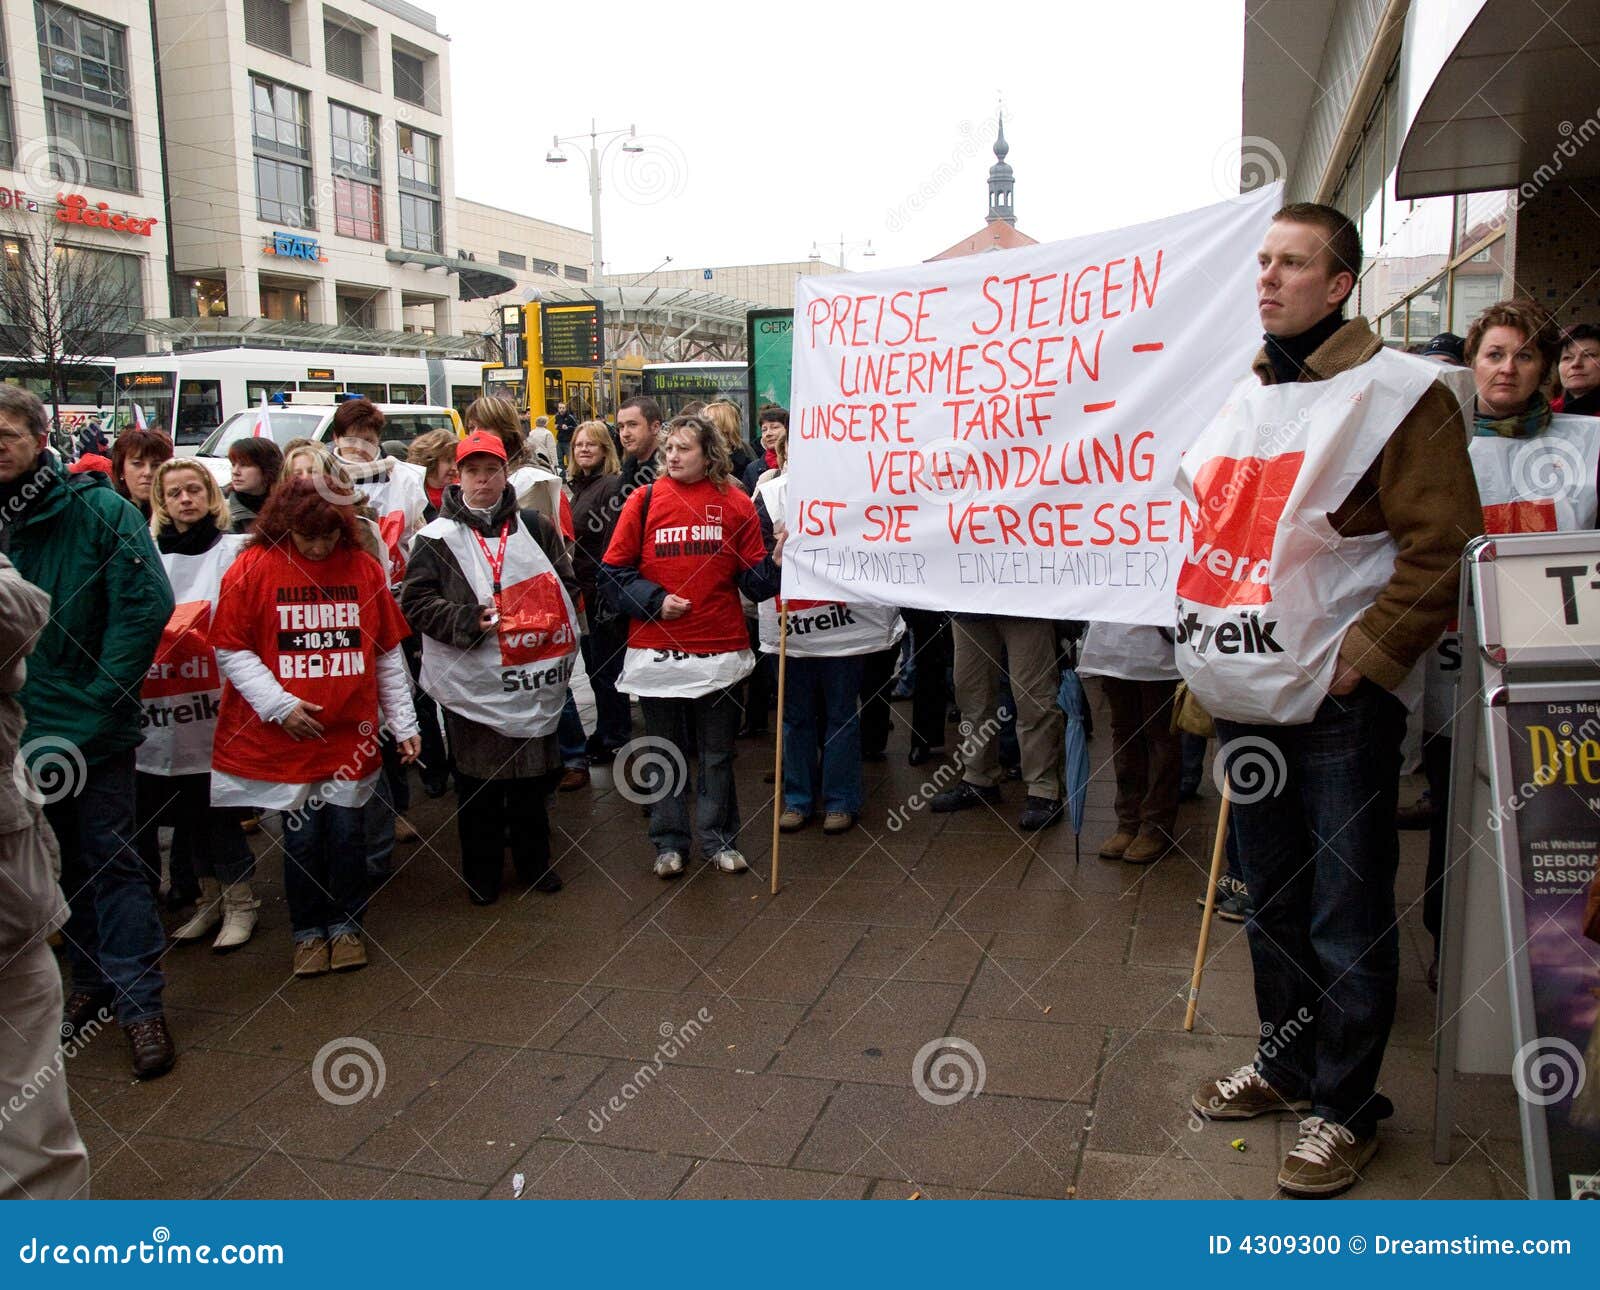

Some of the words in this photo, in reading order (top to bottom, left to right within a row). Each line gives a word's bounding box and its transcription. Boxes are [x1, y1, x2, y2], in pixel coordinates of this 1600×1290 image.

[56, 192, 157, 236] Leiser
[274, 234, 319, 263] DAK
[808, 286, 948, 349] PREISE
[972, 250, 1163, 335] STEIGEN
[839, 330, 1104, 397] UNERMESSEN
[655, 374, 665, 389] 10
[800, 402, 917, 444] UNSERE
[943, 391, 1056, 441] TARIF
[867, 431, 1155, 495] VERHANDLUNG
[655, 527, 689, 544] JETZT
[691, 525, 723, 540] SIND
[798, 500, 847, 537] IST
[862, 504, 918, 543] SIE
[947, 500, 1199, 546] VERGESSEN
[276, 586, 318, 602] ALLES
[322, 585, 359, 600] WIRD
[276, 603, 361, 630] TEURER
[146, 663, 173, 679] er
[1547, 704, 1572, 714] Das
